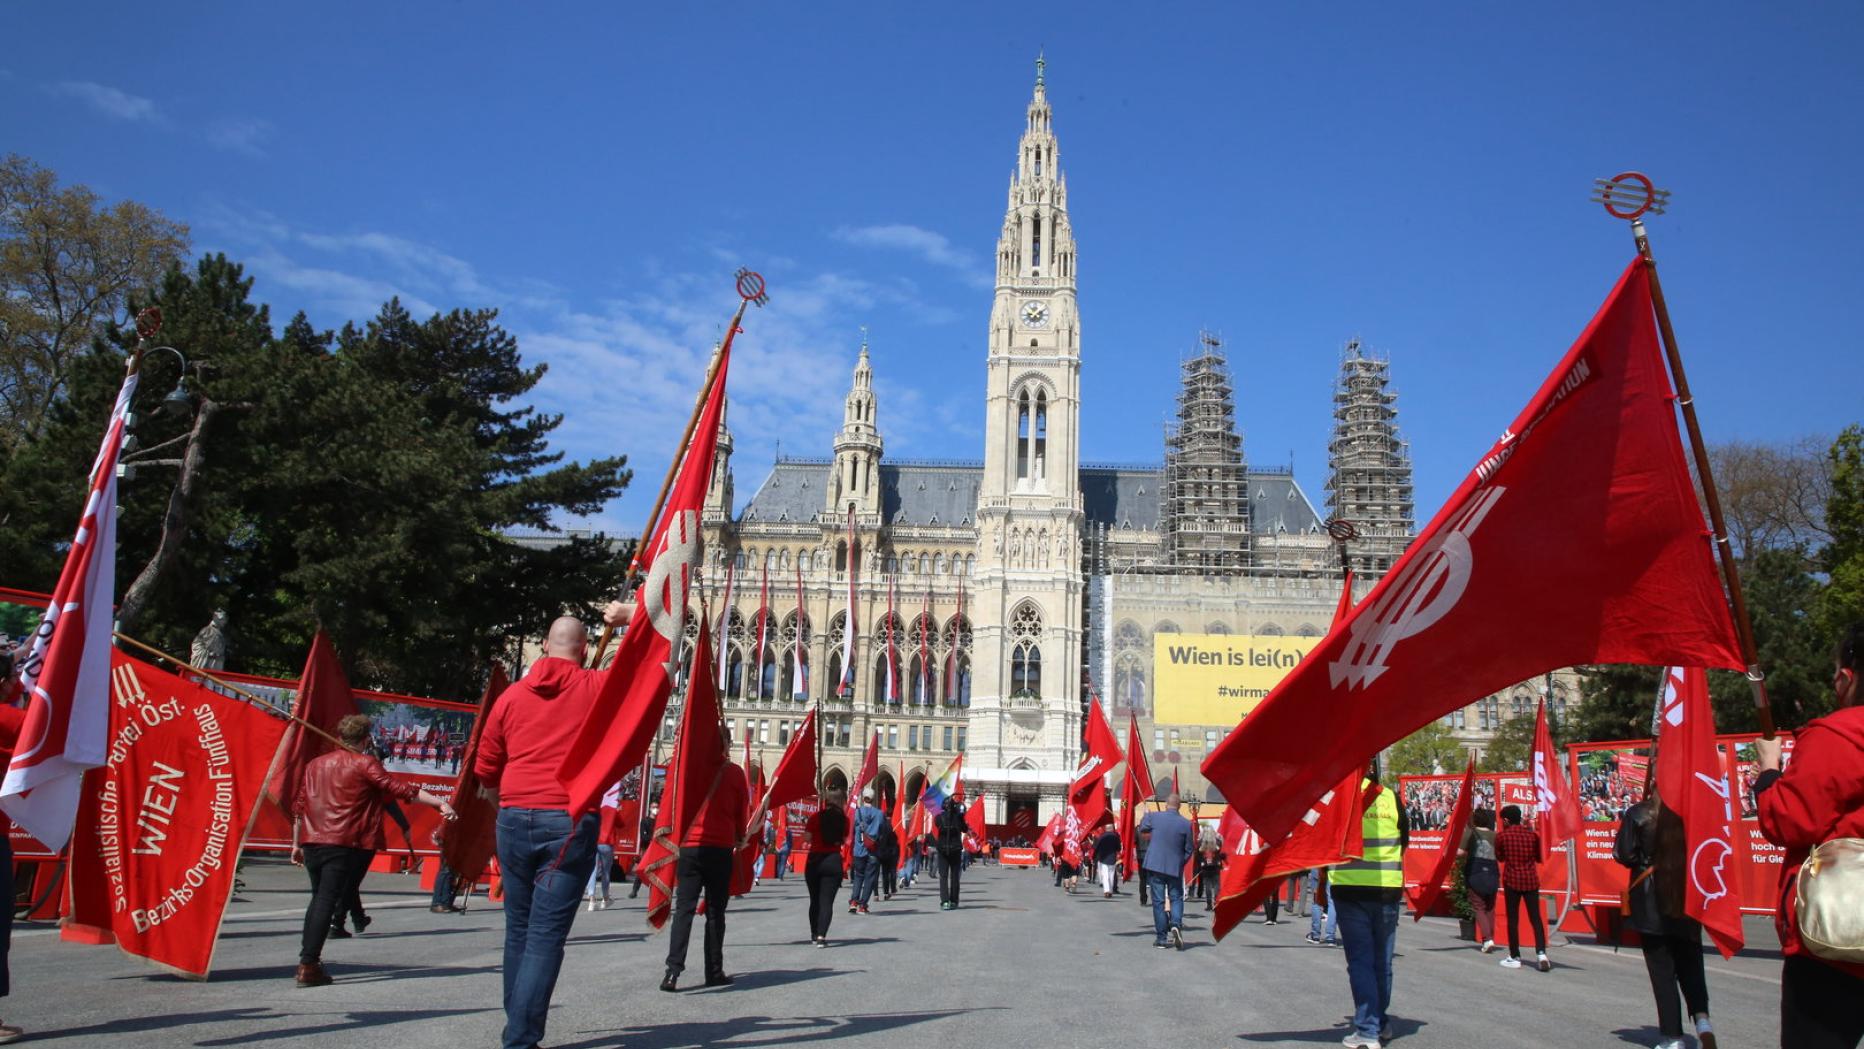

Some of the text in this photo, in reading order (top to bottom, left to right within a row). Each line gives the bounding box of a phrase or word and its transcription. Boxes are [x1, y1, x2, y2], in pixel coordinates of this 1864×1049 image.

[1169, 646, 1223, 666] Wien
[1228, 647, 1245, 667] is
[137, 696, 186, 727] Öst.
[193, 703, 232, 780] Fünfhaus
[131, 761, 185, 856] WIEN
[1585, 829, 1609, 838] Wiens
[1751, 842, 1775, 851] hoch
